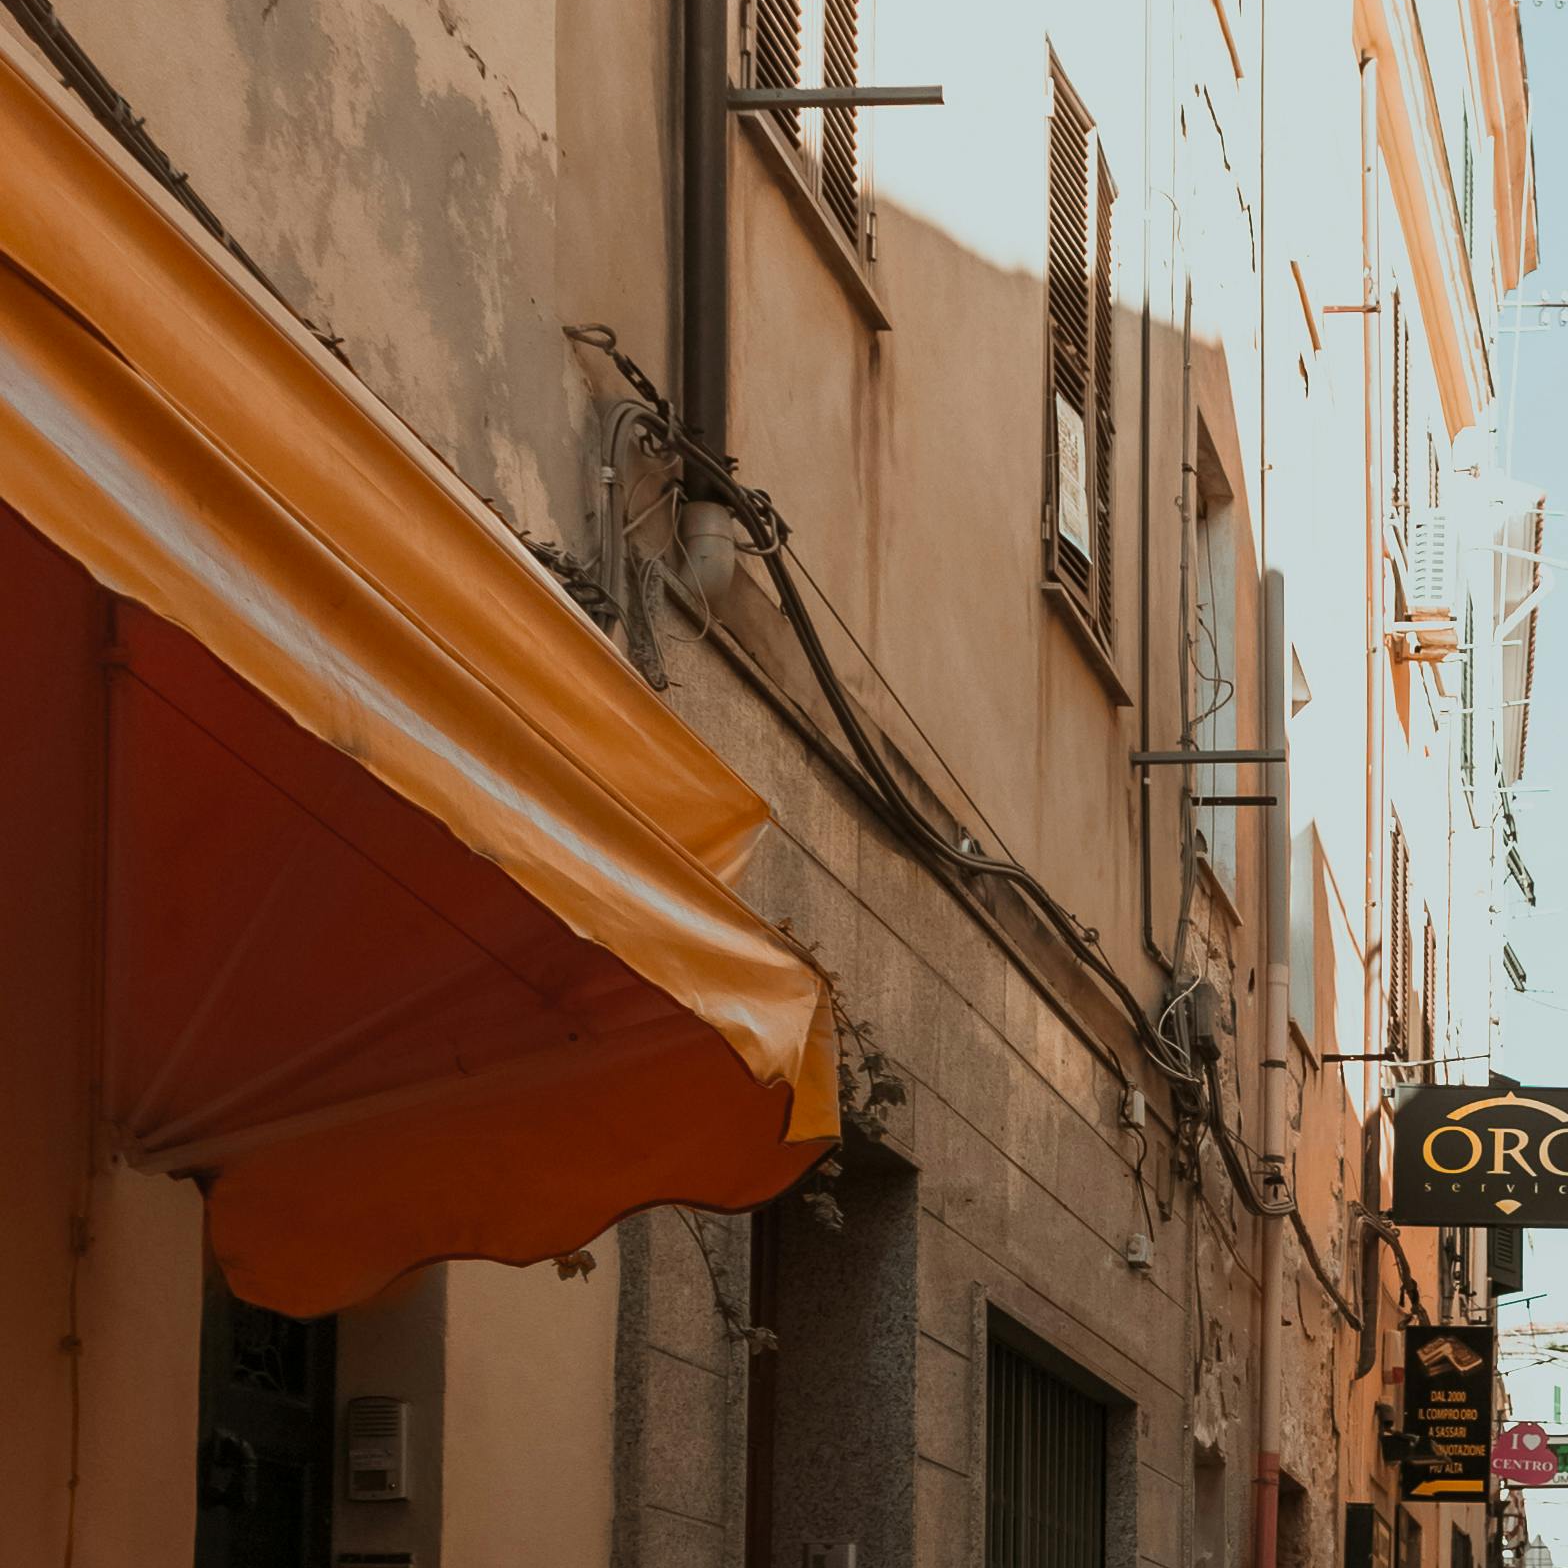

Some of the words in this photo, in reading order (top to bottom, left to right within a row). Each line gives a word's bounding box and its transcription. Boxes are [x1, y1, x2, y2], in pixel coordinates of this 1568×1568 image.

[1431, 1391, 1446, 1402] DAL
[1426, 1409, 1460, 1420] COMPRO
[1460, 1409, 1478, 1420] ORO
[1435, 1426, 1466, 1437] SASSARI
[1511, 1433, 1519, 1450] I
[1492, 1458, 1553, 1472] CENTRO
